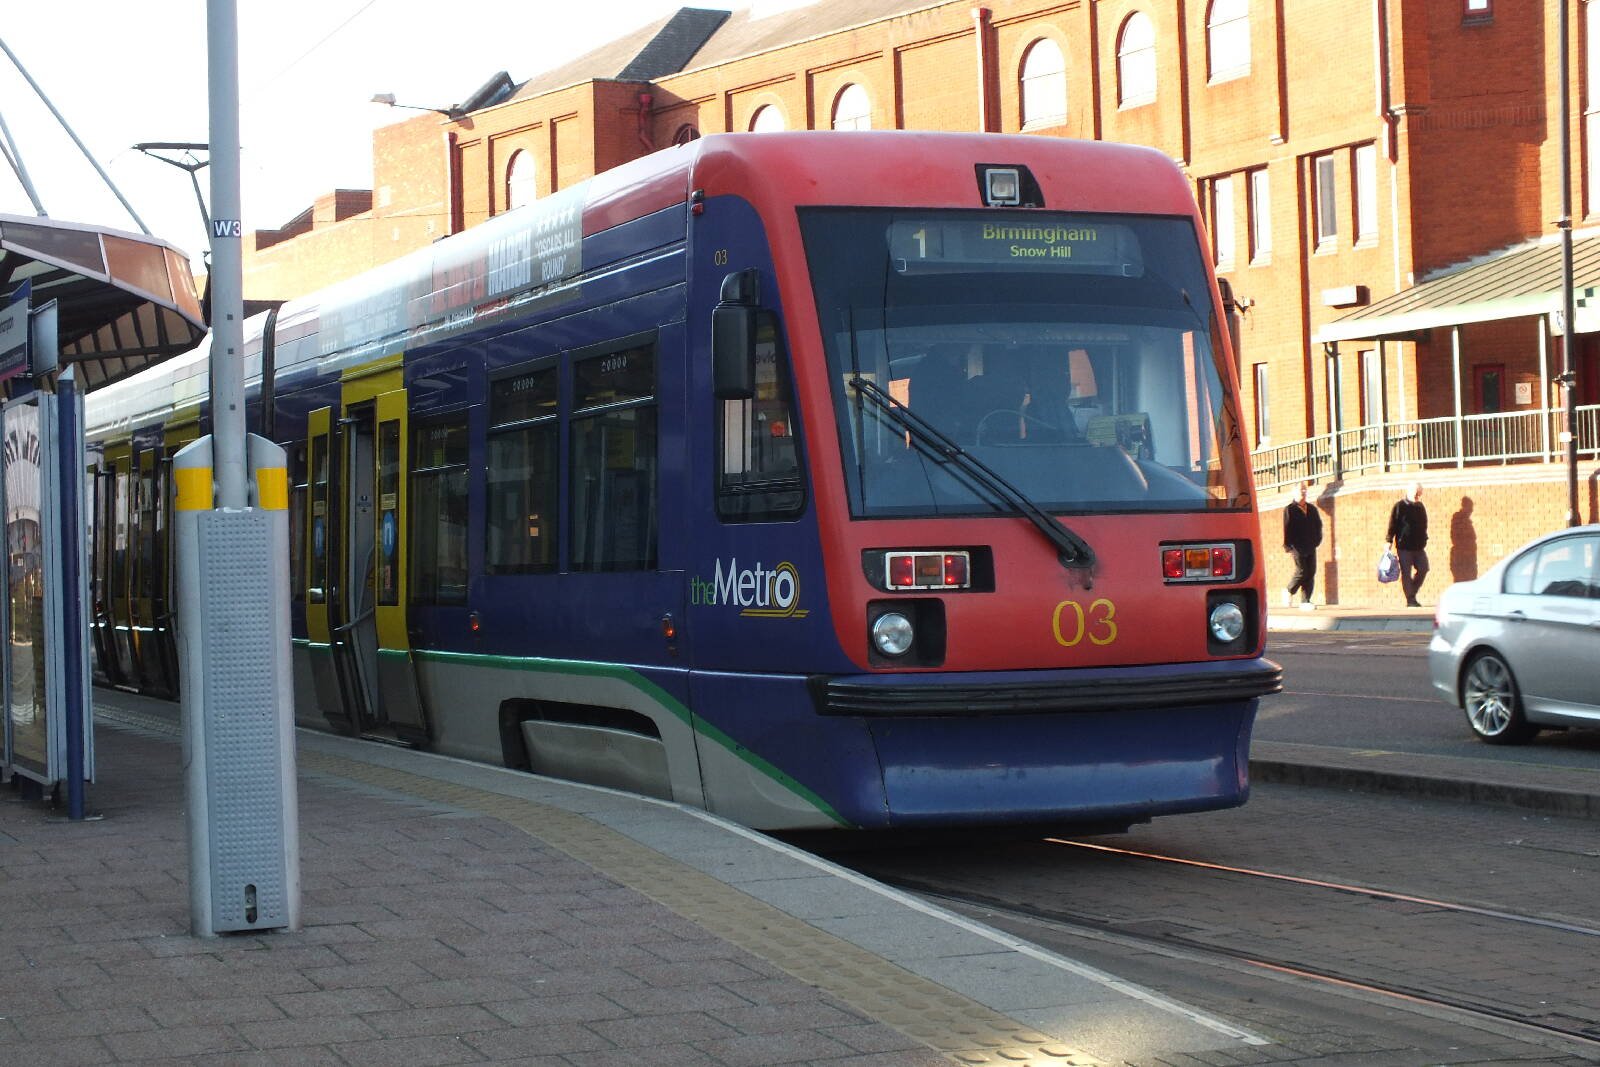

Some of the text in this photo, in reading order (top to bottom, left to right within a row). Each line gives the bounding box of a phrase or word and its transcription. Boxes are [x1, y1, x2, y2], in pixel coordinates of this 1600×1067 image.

[214, 220, 241, 237] W3
[983, 223, 1097, 243] Birmingham
[912, 228, 926, 258] 1
[1010, 245, 1072, 258] Snow Hill
[714, 249, 728, 266] 03
[1052, 598, 1118, 647] 03
